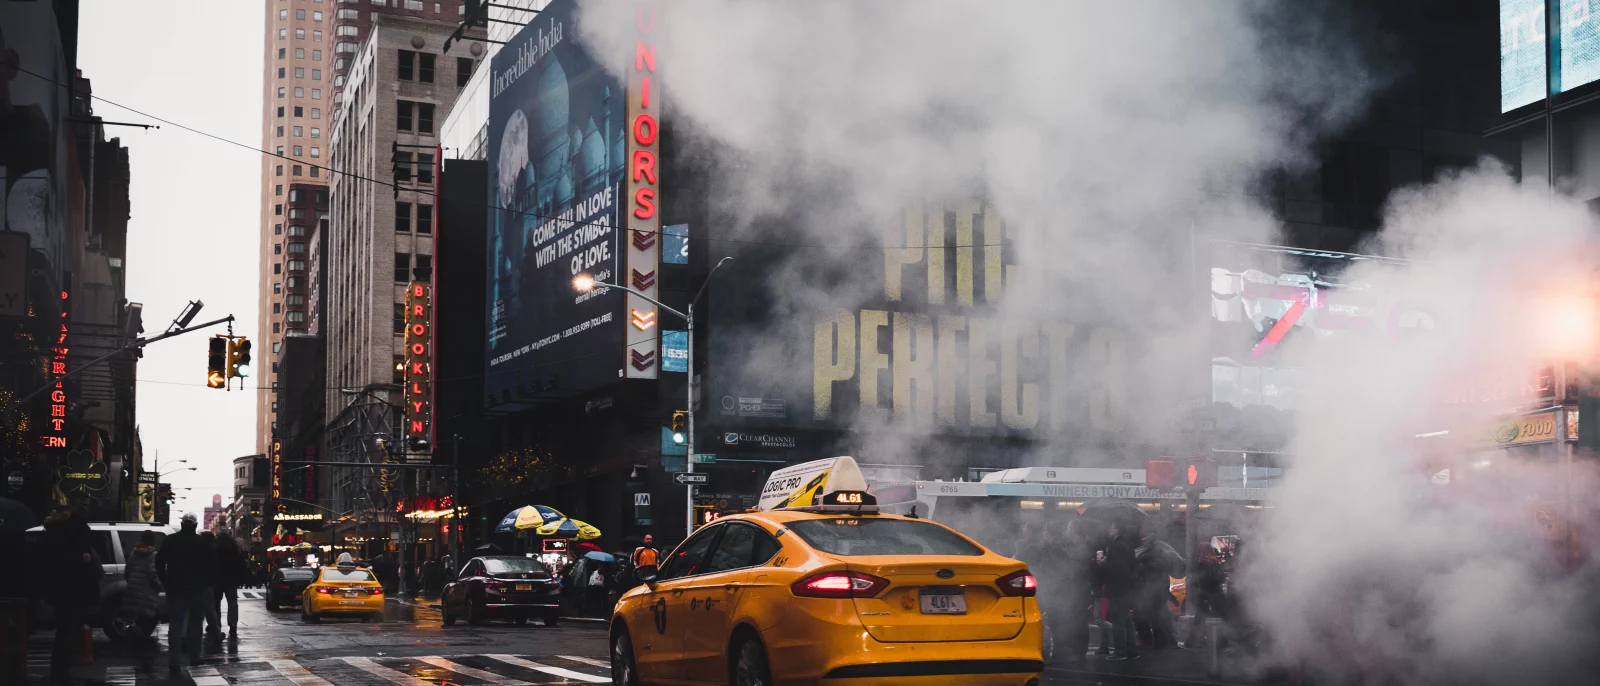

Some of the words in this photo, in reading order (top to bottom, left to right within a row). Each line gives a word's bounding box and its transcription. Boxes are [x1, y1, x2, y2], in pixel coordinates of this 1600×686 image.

[492, 37, 538, 99] Incredible
[538, 17, 563, 60] India
[533, 219, 555, 247] COME
[557, 208, 574, 234] FALL
[576, 201, 586, 222] IN
[588, 186, 612, 217] LOVE
[536, 243, 556, 269] WITH
[557, 233, 573, 258] THE
[574, 213, 611, 250] SYMBOL
[571, 252, 584, 275] OF
[585, 240, 611, 269] LOVE.
[411, 285, 425, 432] BROOKLYN
[814, 308, 1074, 430] PERFECT
[1088, 327, 1128, 431] 3
[1519, 419, 1553, 438] FOOD
[764, 479, 786, 493] LOGIC
[786, 476, 802, 490] PRO
[837, 493, 862, 503] 4L61
[940, 485, 958, 493] 6765
[1041, 485, 1088, 497] WINNER
[1100, 486, 1131, 498] TONY
